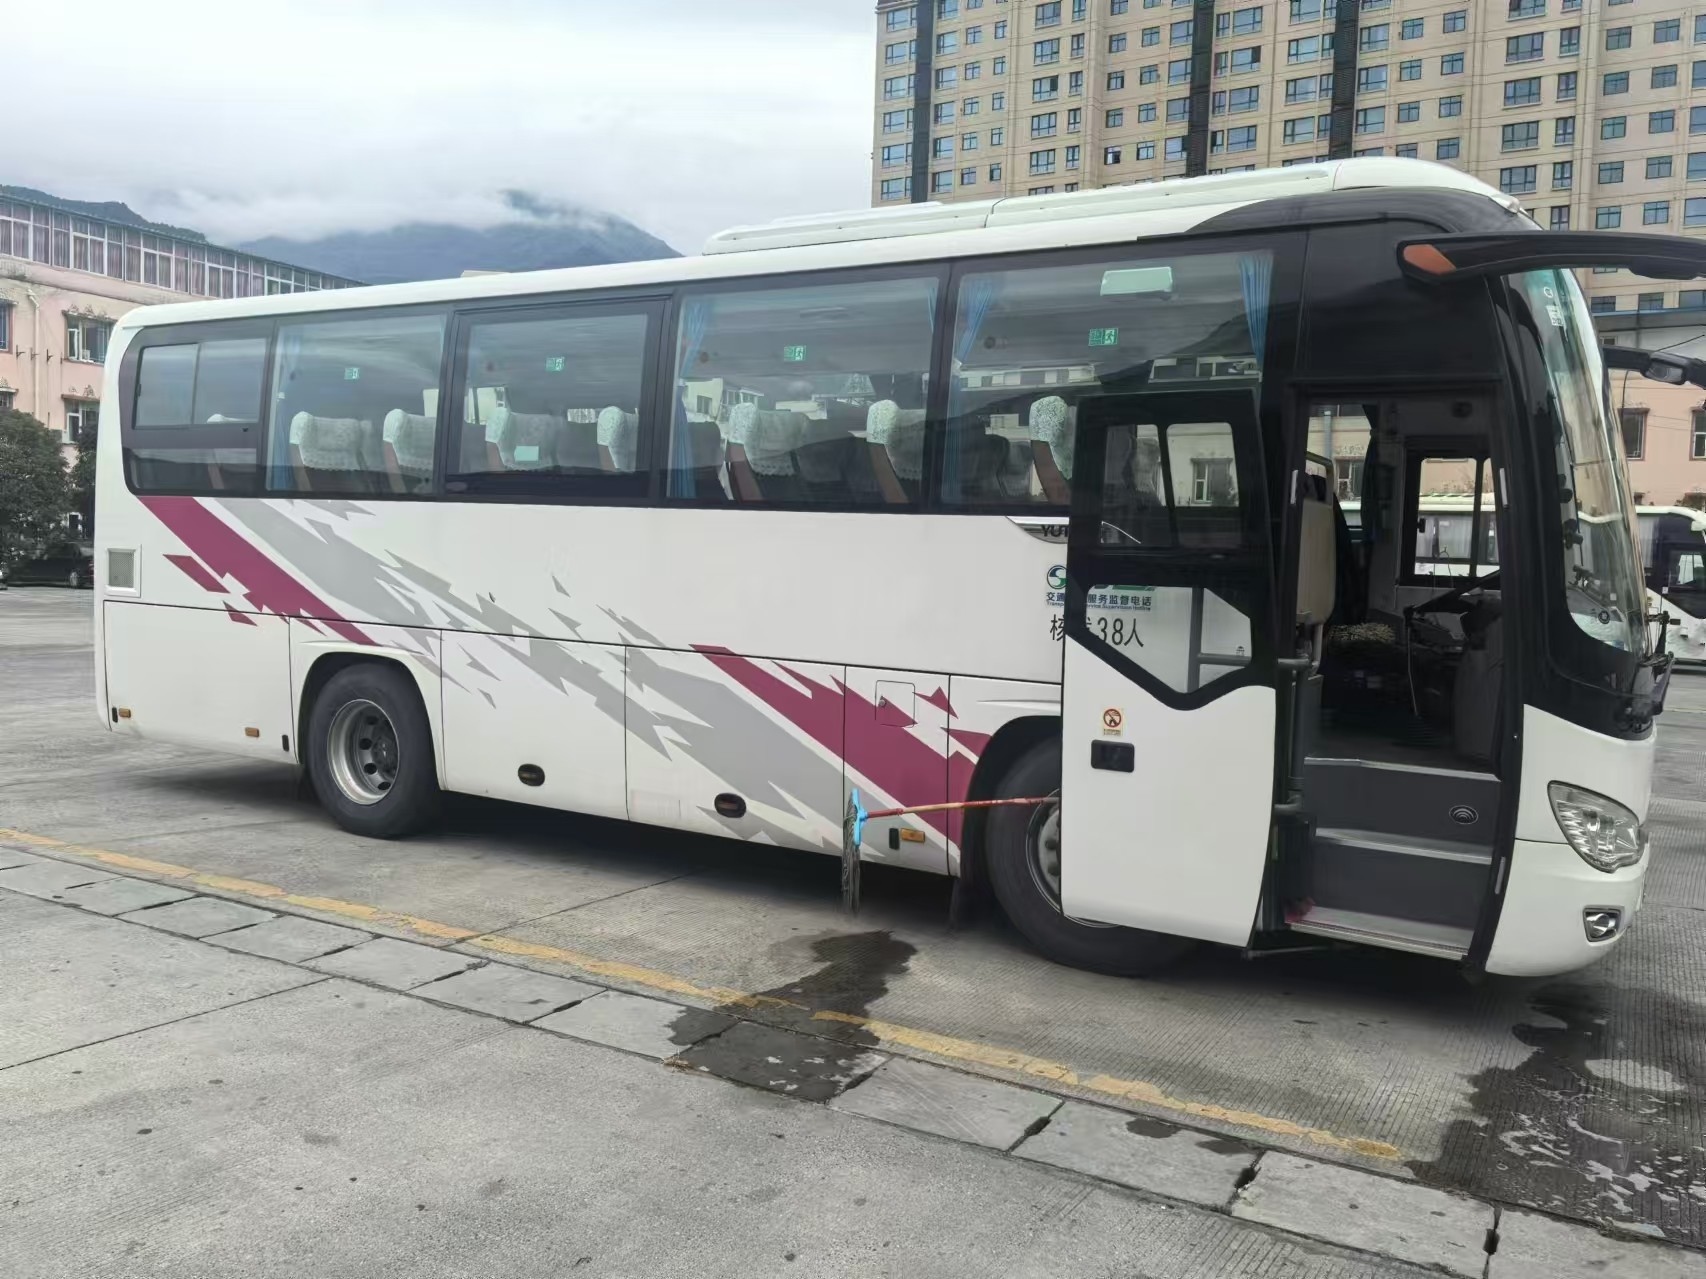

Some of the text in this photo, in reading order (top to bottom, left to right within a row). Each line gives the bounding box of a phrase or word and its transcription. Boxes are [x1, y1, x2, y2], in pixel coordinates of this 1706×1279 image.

[1041, 524, 1069, 537] YUT
[1046, 592, 1152, 607] 交通服务监督电话
